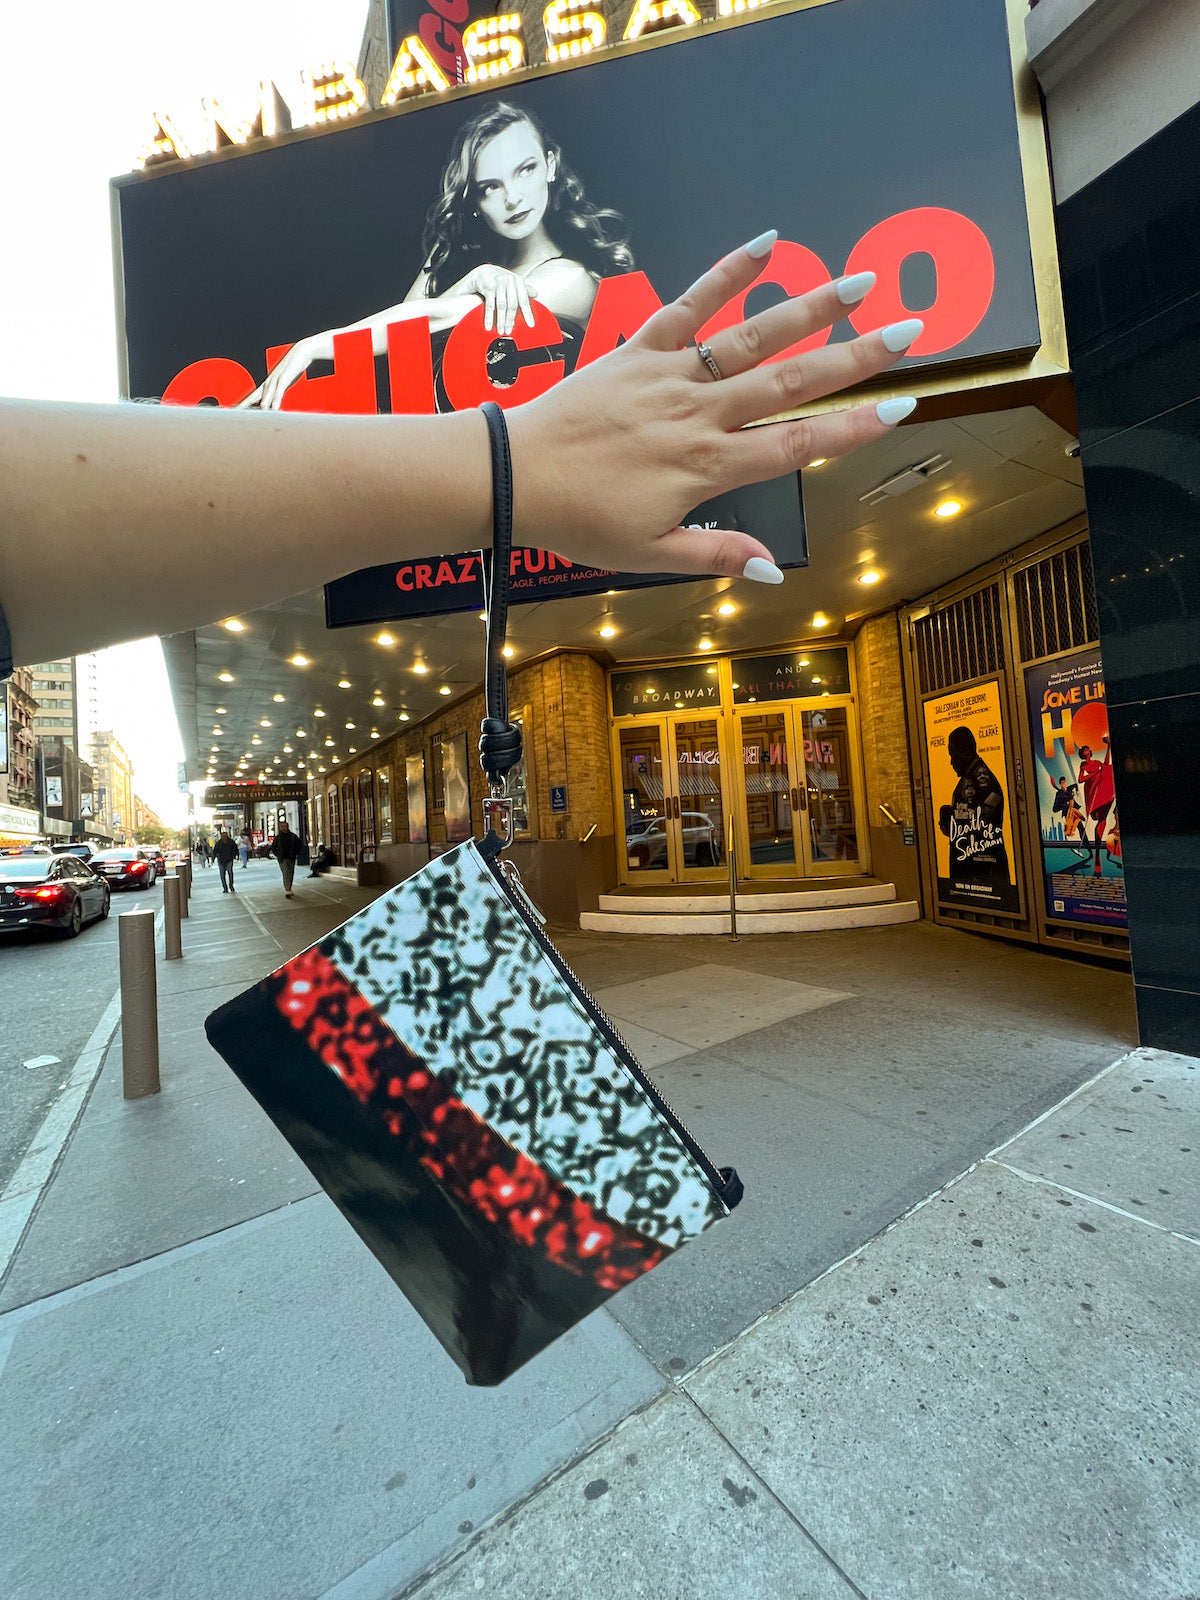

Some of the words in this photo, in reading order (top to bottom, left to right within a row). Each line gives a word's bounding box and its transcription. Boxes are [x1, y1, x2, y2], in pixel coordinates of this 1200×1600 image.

[132, 0, 772, 172] AMBASSA
[395, 556, 482, 591] CRAZ
[539, 574, 568, 585] PEOPLE
[776, 665, 803, 675] AND
[769, 680, 801, 692] THAT
[808, 674, 843, 689] JZZ
[632, 687, 717, 705] BROADWAY,
[1041, 687, 1082, 712] SOME
[979, 727, 998, 739] CLARKE
[950, 806, 988, 842] Death
[983, 823, 994, 839] of
[956, 834, 1003, 861] Salesman
